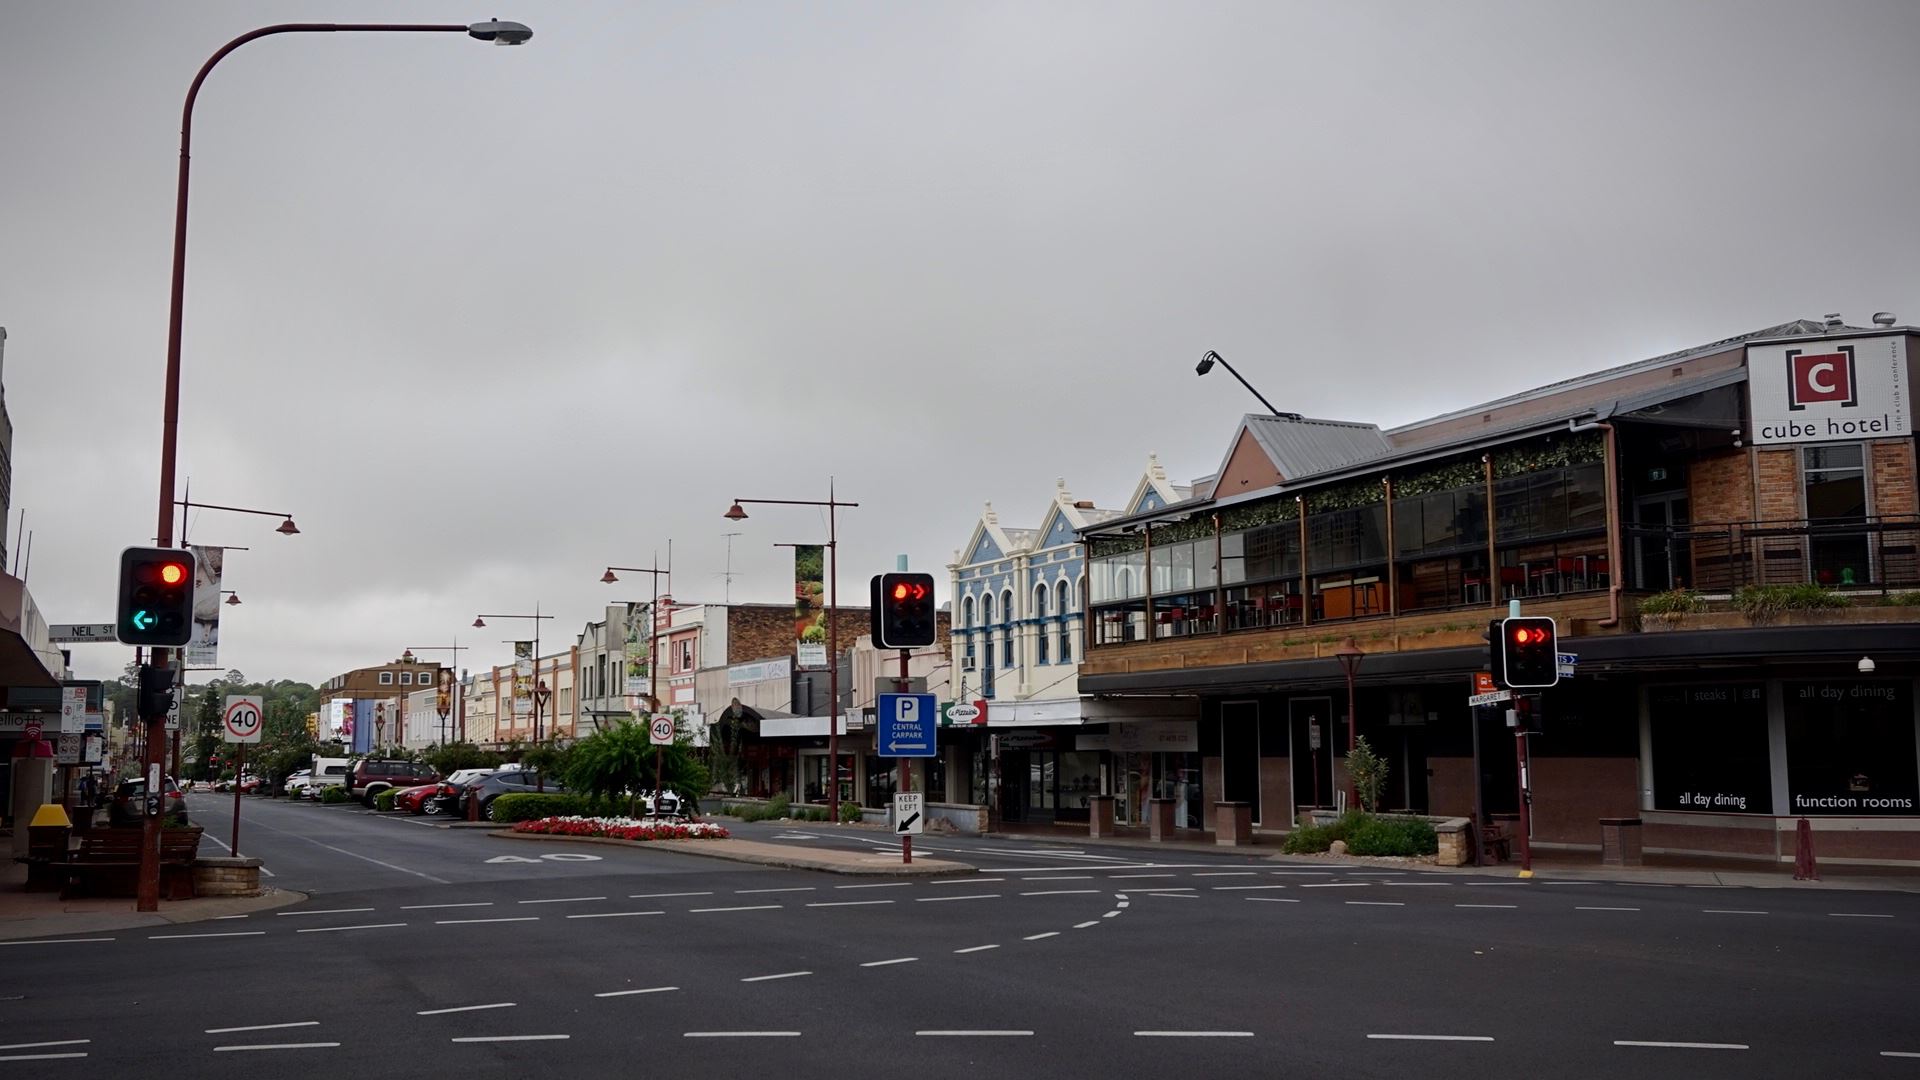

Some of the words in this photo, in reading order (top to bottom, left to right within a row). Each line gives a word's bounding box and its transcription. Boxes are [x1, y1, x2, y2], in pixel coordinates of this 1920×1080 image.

[1891, 341, 1899, 382] conference
[1893, 391, 1901, 407] club
[1762, 420, 1816, 439] cube
[1828, 413, 1889, 434] hotel
[72, 626, 95, 636] NEIL
[103, 626, 113, 634] ST
[1471, 692, 1501, 703] MARGARET
[1694, 688, 1727, 701] steaks
[1800, 684, 1815, 698] all
[1820, 684, 1845, 701] day
[1850, 683, 1896, 701] dining
[902, 700, 913, 718] P
[231, 710, 257, 727] 40
[654, 723, 670, 735] 40
[892, 723, 922, 731] CENTRAL
[898, 795, 918, 803] KEEP
[1679, 792, 1691, 804] all
[1694, 792, 1711, 808] day
[1714, 793, 1746, 809] dining
[1795, 794, 1857, 808] function
[1863, 797, 1913, 809] rooms
